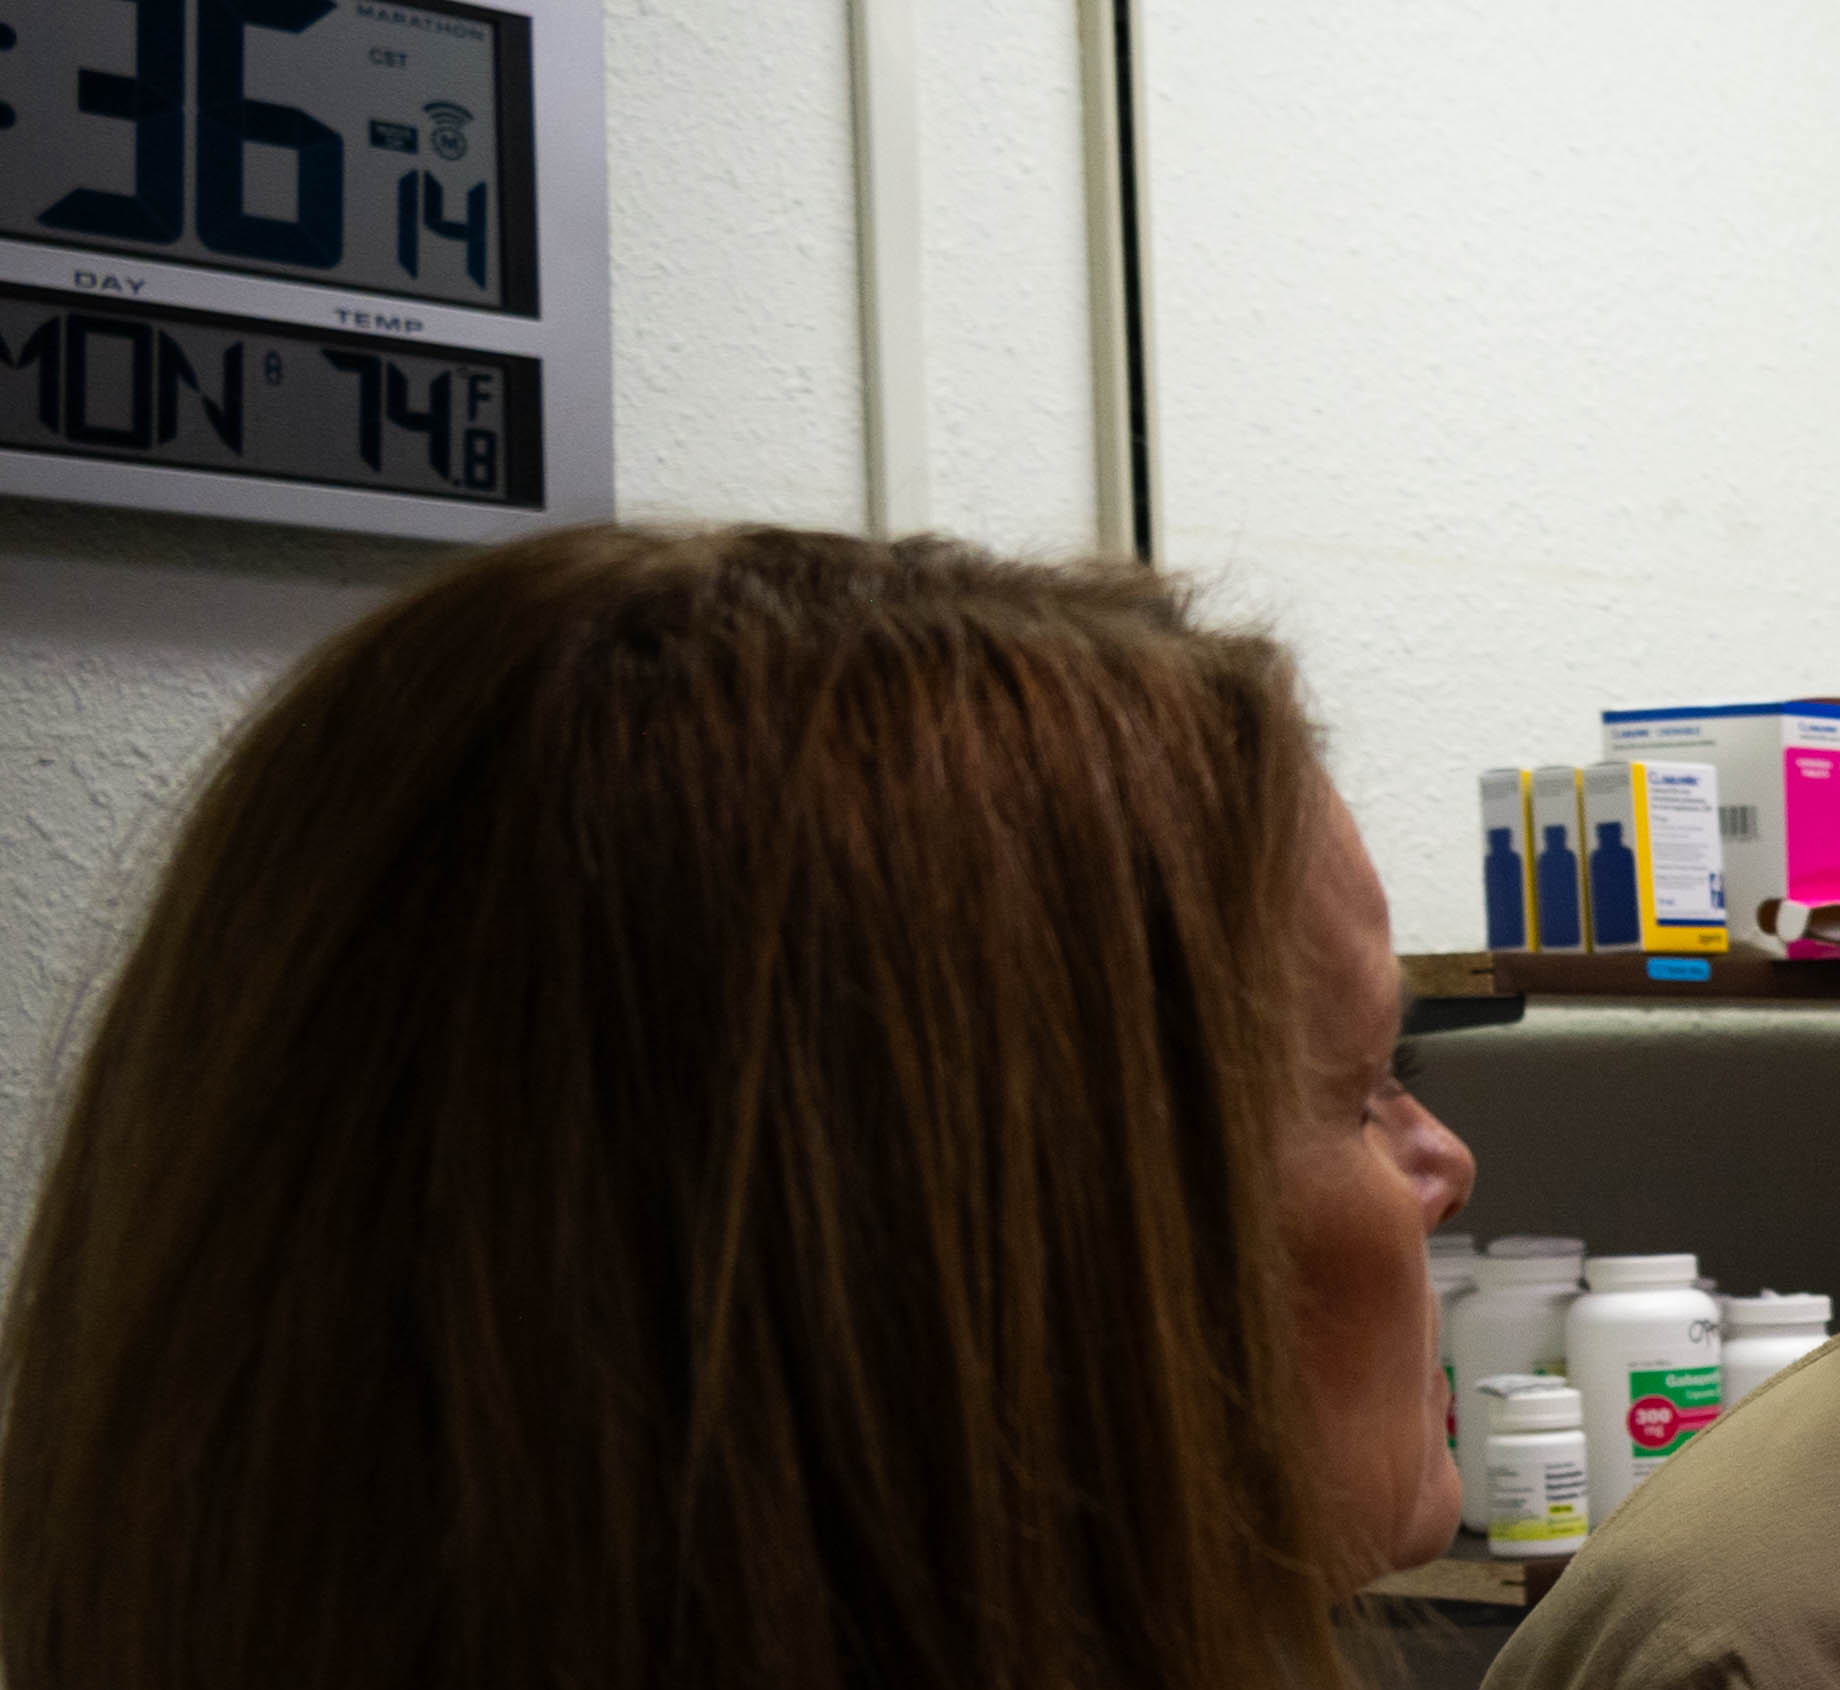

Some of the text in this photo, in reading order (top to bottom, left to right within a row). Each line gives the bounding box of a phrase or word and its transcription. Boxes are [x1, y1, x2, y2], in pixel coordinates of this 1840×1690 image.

[355, 3, 486, 42] MARATHON
[397, 169, 487, 290] 14
[73, 269, 148, 296] DAY
[334, 307, 425, 334] TEMP
[0, 315, 243, 456] MON
[1635, 1408, 1673, 1425] 300
[1643, 1424, 1665, 1439] mg
